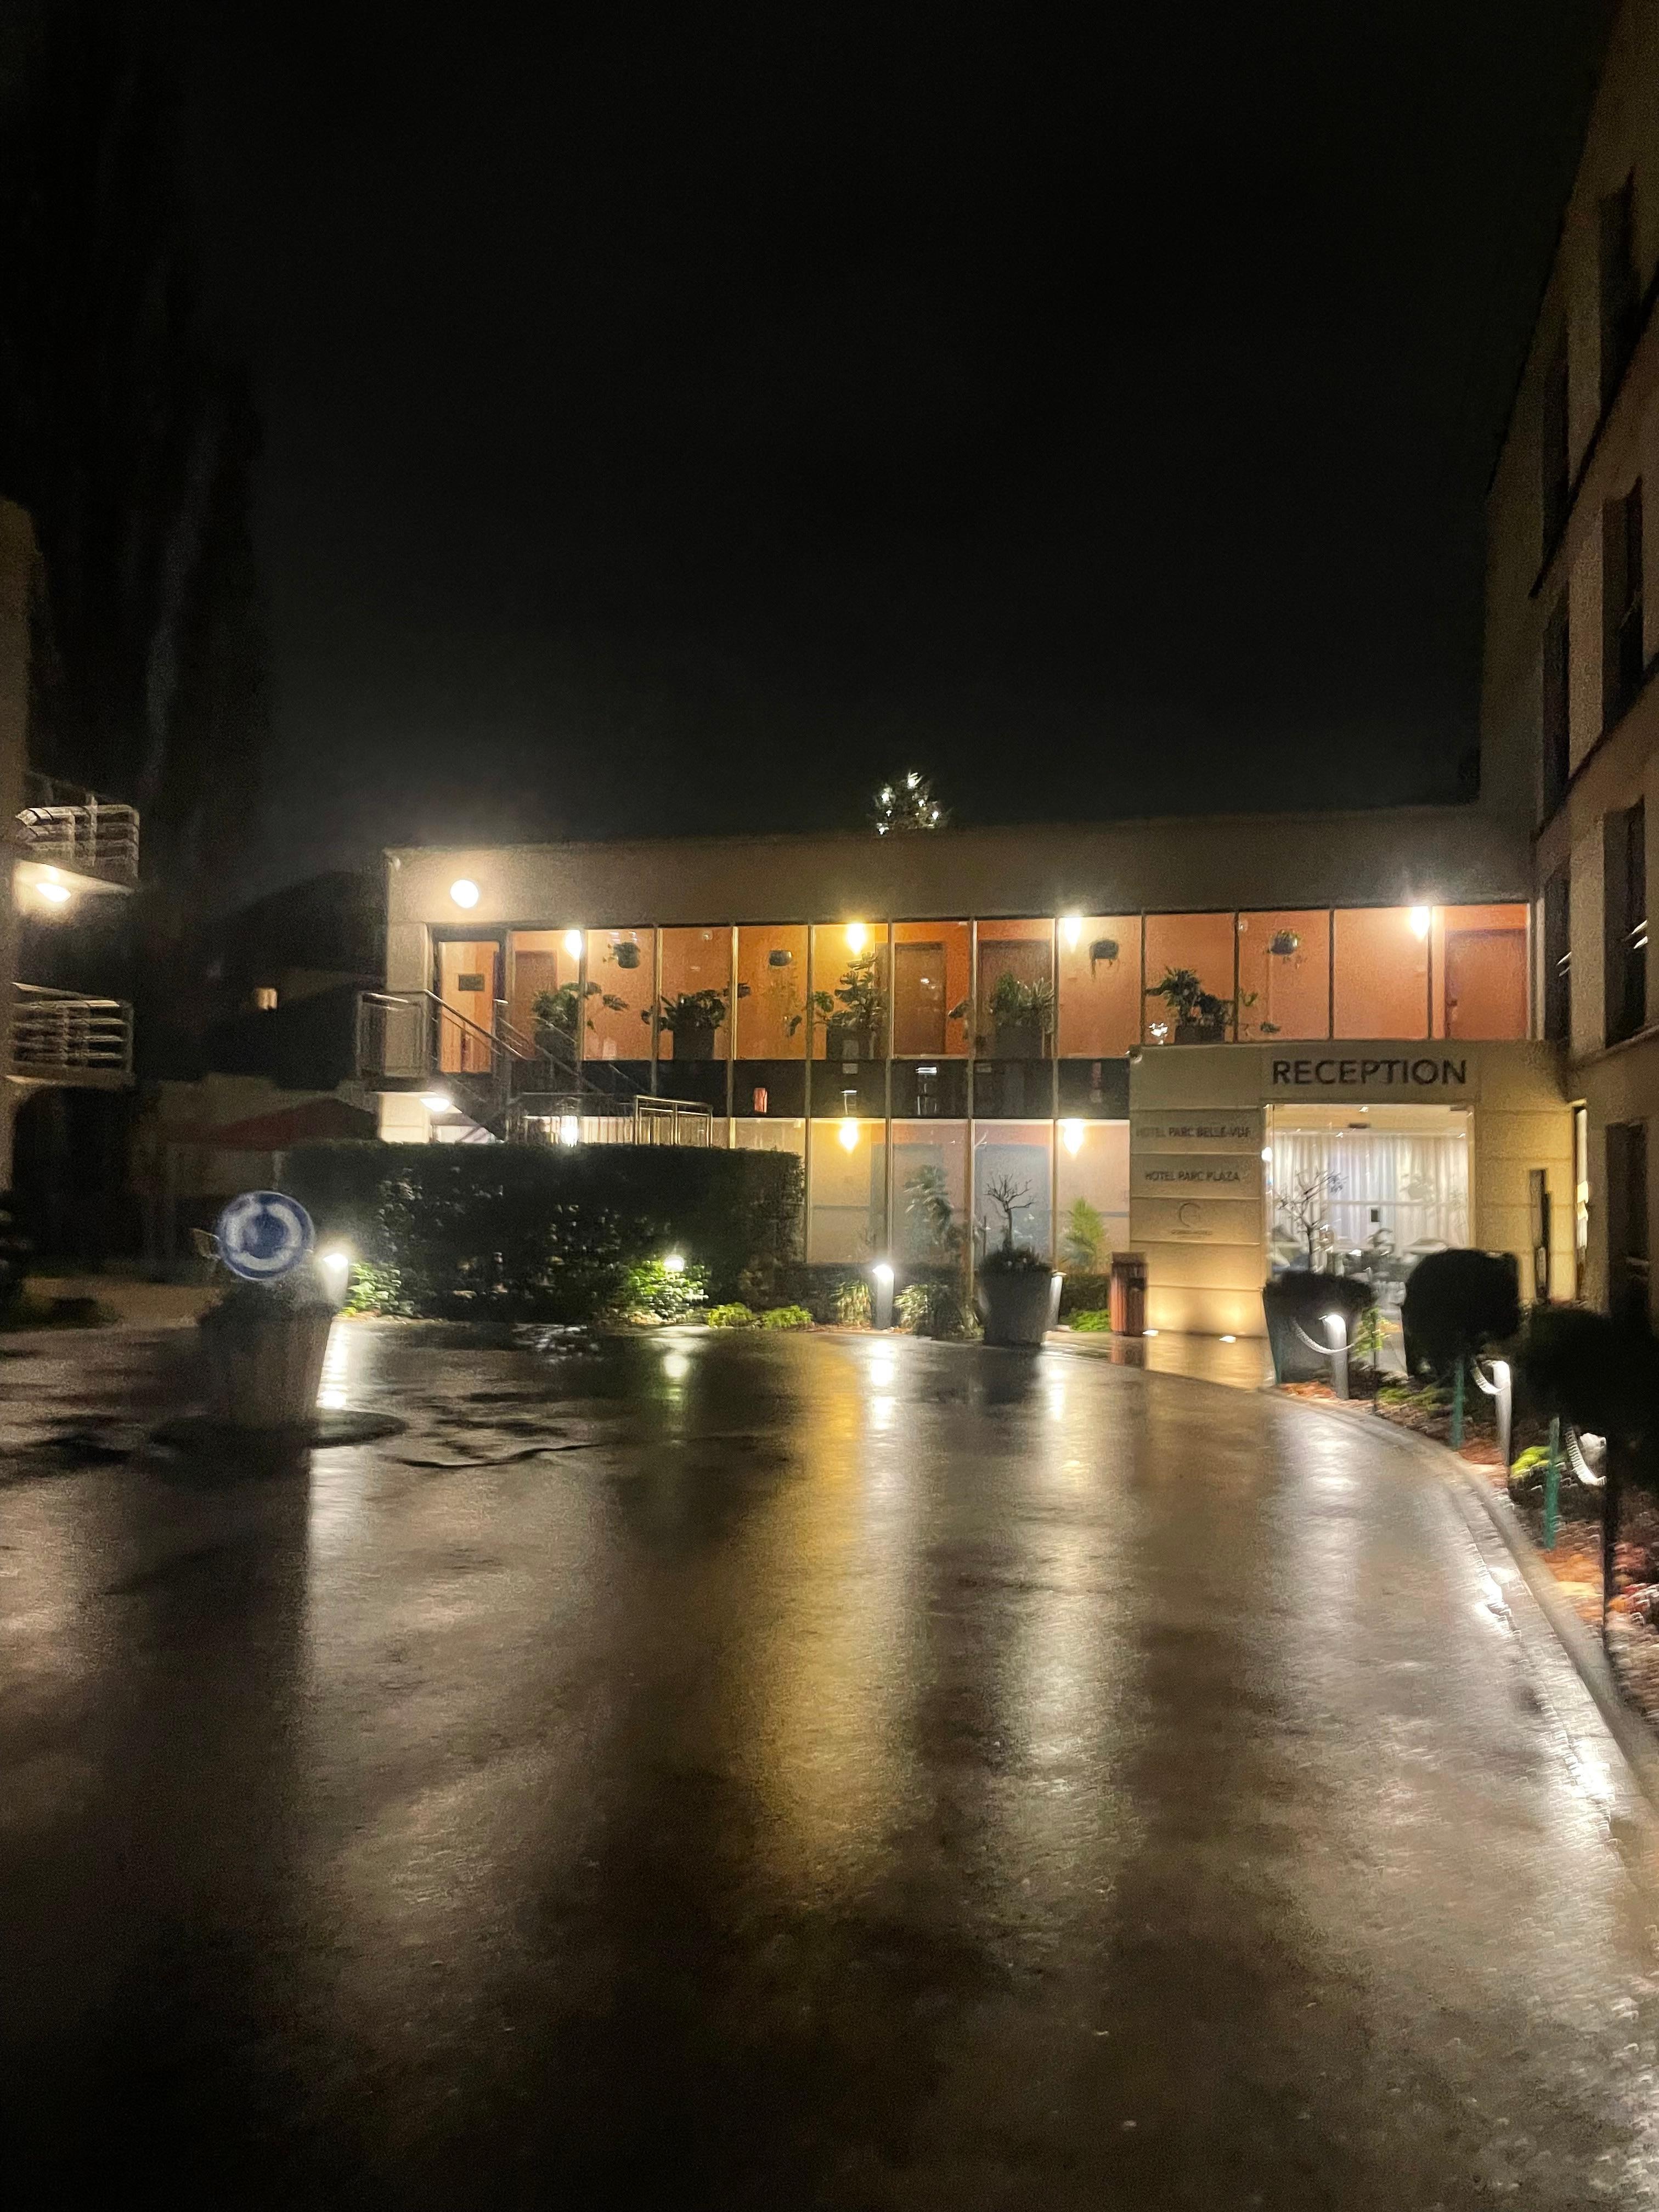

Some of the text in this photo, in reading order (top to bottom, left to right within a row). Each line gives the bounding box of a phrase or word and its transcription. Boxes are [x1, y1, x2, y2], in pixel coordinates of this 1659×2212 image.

[1273, 1059, 1467, 1085] RECEPTION
[1169, 1126, 1194, 1137] PARC
[1145, 1171, 1240, 1182] HOTEL PARC PLAZA
